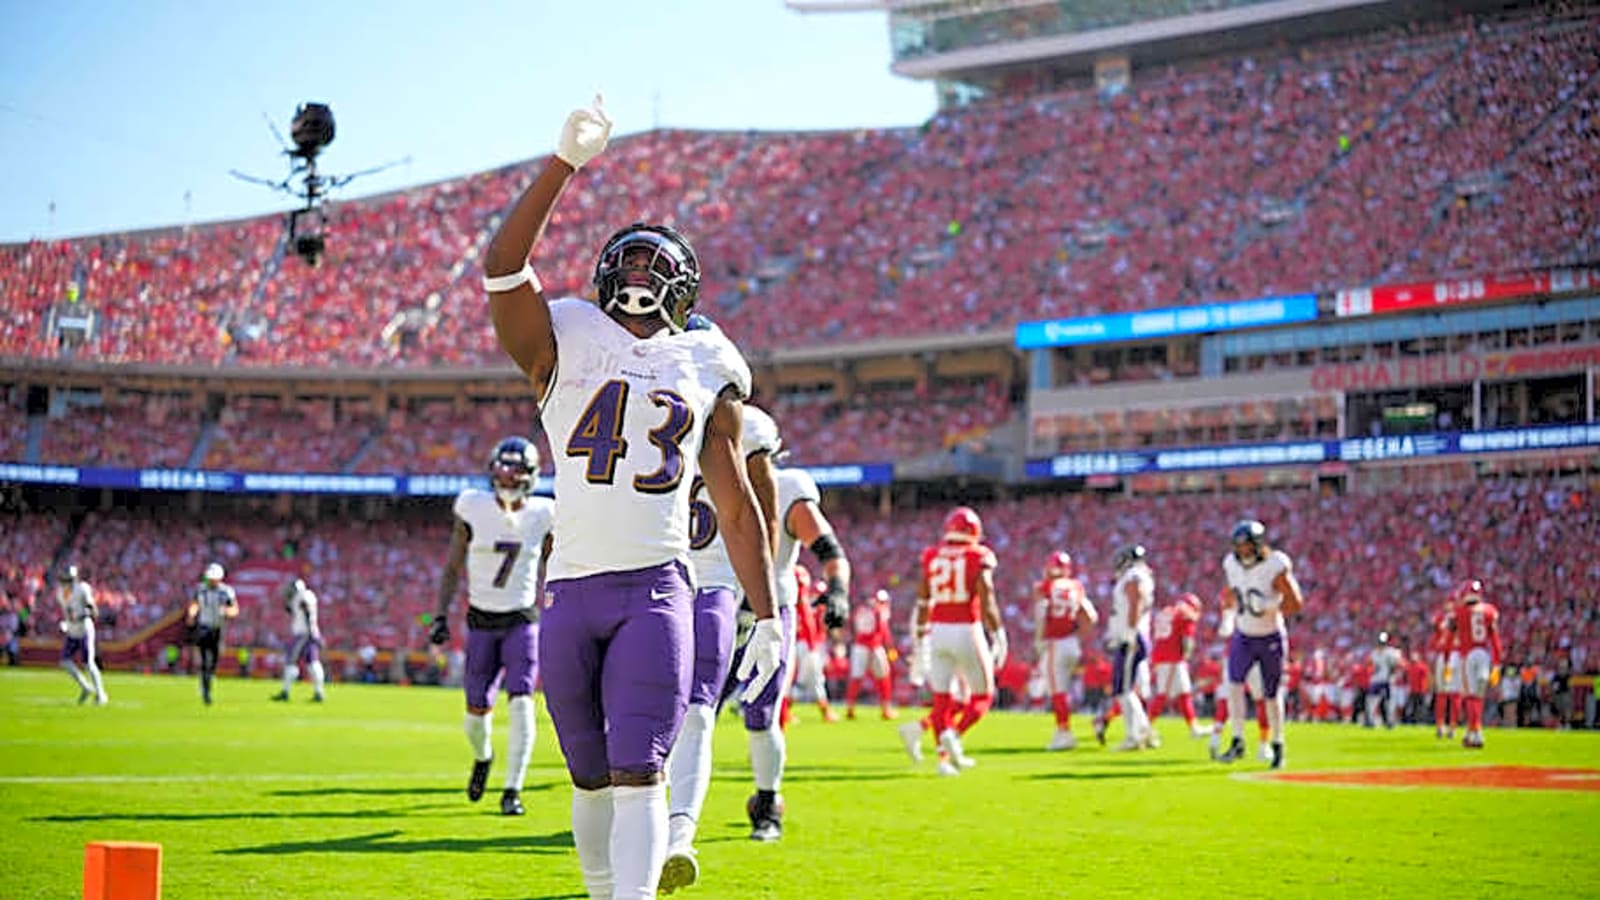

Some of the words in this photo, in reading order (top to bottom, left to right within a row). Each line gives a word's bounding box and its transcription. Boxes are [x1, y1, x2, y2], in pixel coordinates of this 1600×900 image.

[1400, 353, 1480, 386] FIELD
[566, 378, 695, 494] 43
[493, 541, 522, 588] 7
[928, 557, 970, 602] 21
